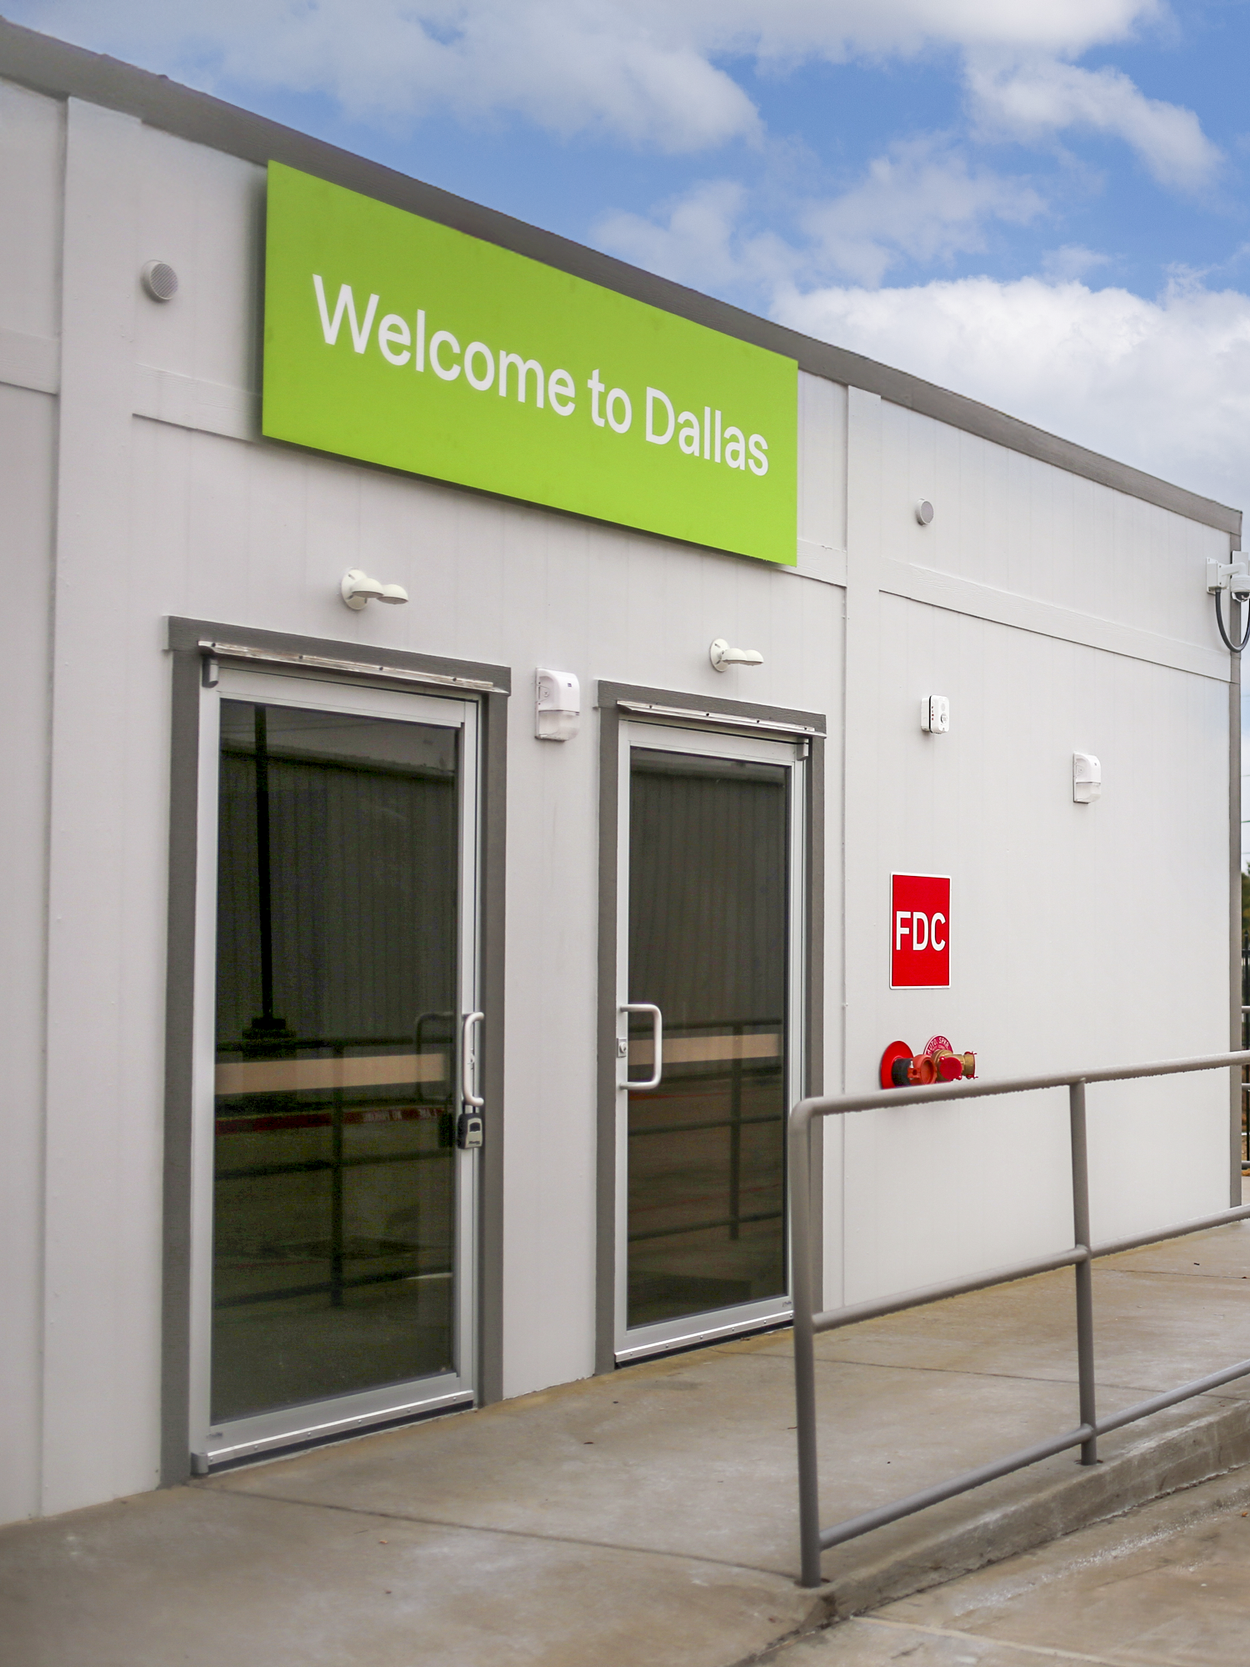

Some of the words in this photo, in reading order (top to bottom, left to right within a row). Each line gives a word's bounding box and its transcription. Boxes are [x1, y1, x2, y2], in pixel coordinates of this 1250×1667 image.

[312, 273, 576, 416] Welcome
[587, 368, 632, 434] to
[646, 386, 769, 476] Dallas
[896, 911, 946, 951] FDC
